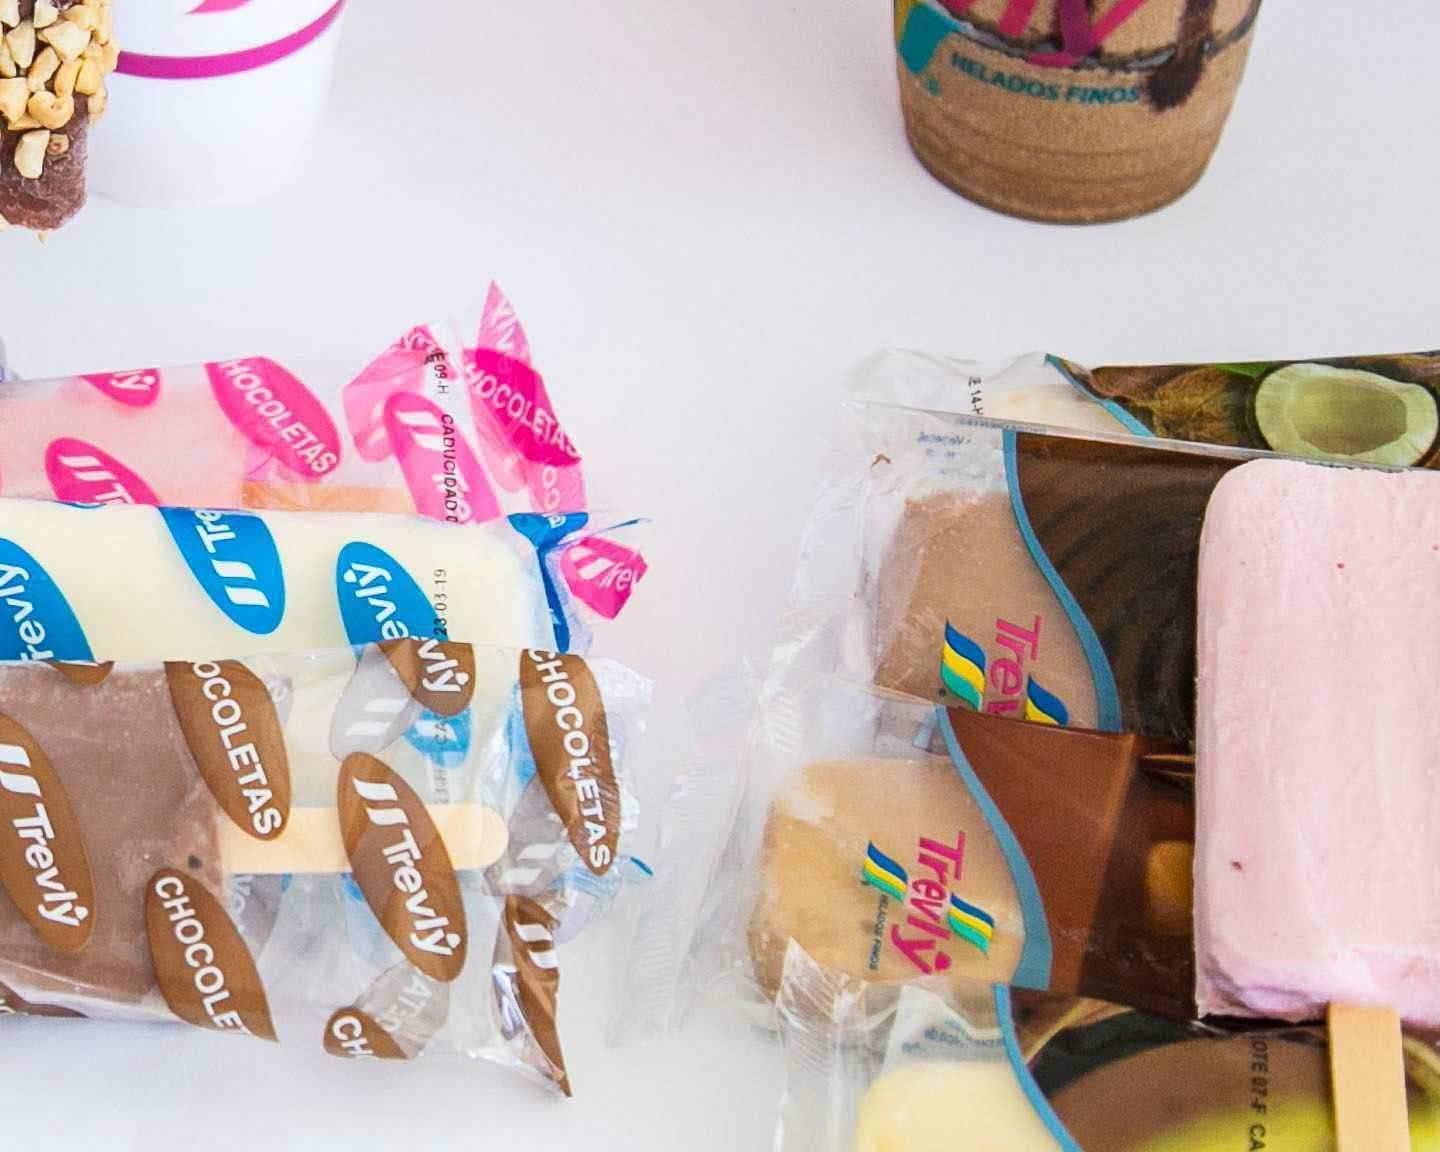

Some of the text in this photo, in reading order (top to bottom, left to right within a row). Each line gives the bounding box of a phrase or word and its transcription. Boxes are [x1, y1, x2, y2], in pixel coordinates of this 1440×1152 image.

[947, 52, 1140, 105] HELADOS FINOS
[526, 647, 613, 870] CHOCOLETAS
[12, 802, 89, 929] Trevly
[382, 832, 461, 957] Trevly
[891, 829, 967, 975] Trevly
